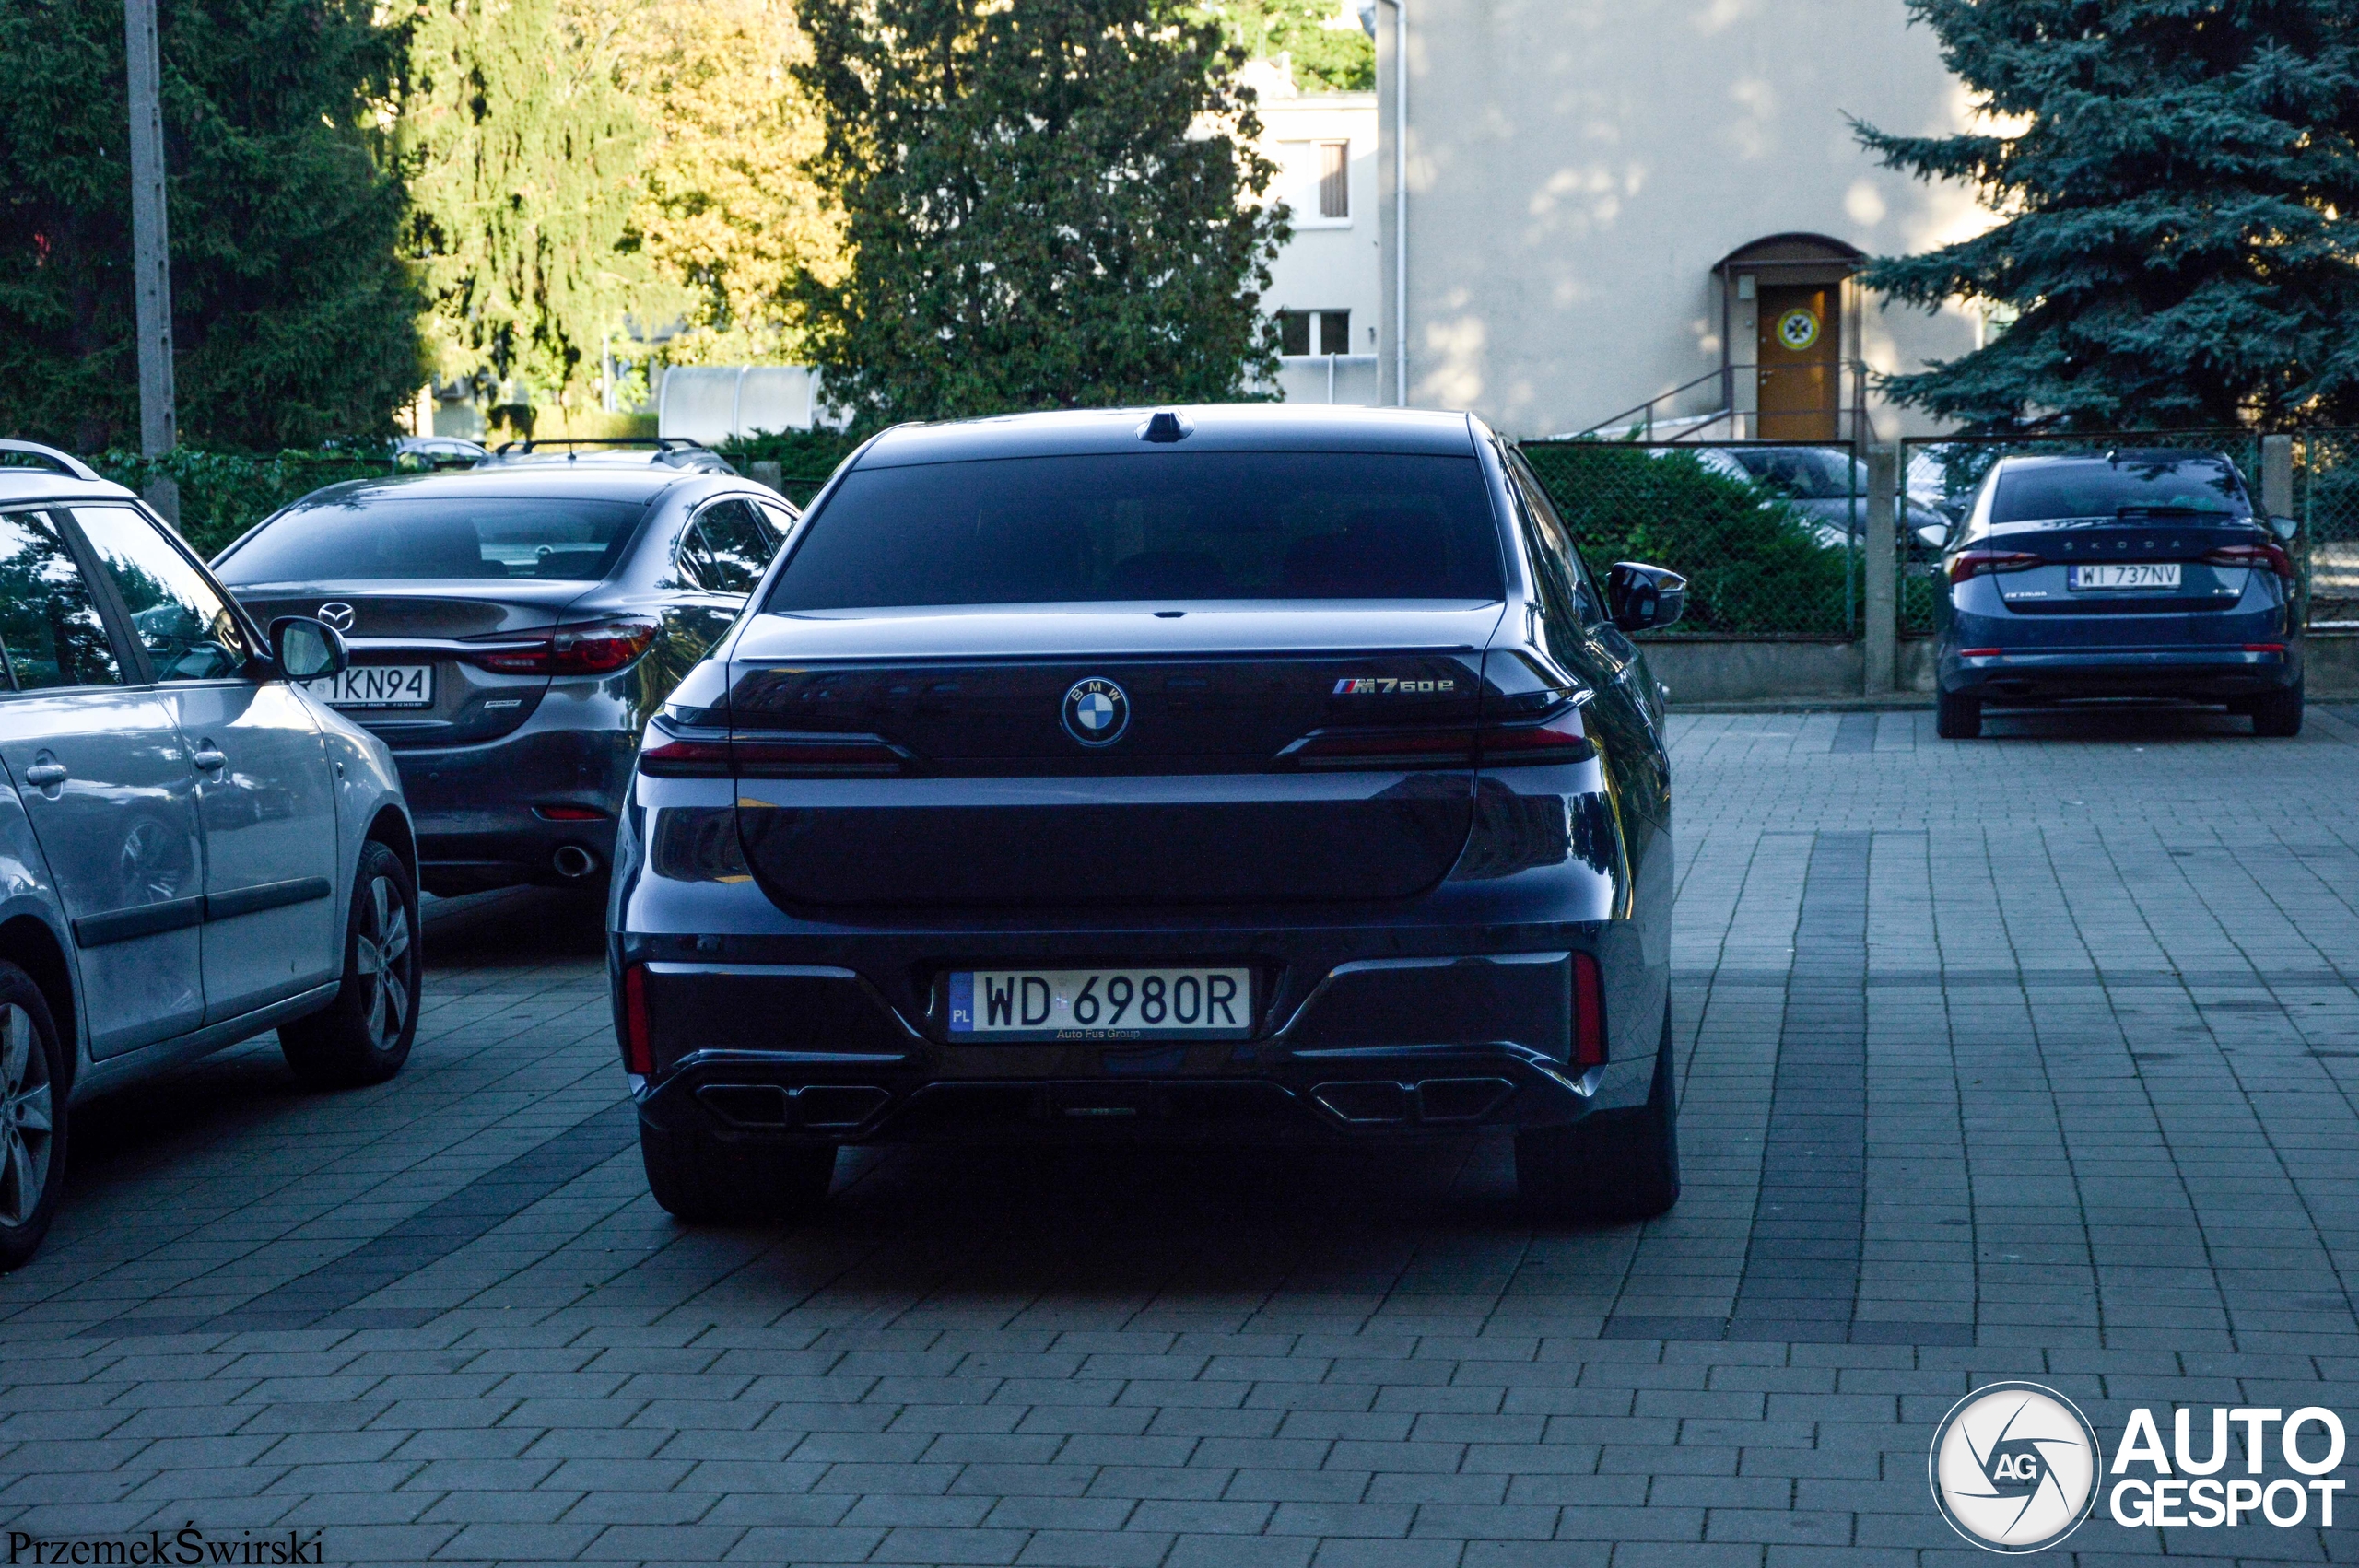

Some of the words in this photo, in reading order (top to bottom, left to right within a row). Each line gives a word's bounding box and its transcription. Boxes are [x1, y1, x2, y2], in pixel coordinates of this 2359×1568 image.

[2083, 568, 2104, 584] WI
[2116, 566, 2177, 584] 737NV
[1071, 682, 1121, 701] BMW
[985, 977, 1050, 1026] WD
[953, 1010, 970, 1023] PL
[1056, 1029, 1083, 1039] Auto
[1085, 1029, 1105, 1038] Fus
[1107, 1029, 1141, 1039] Group
